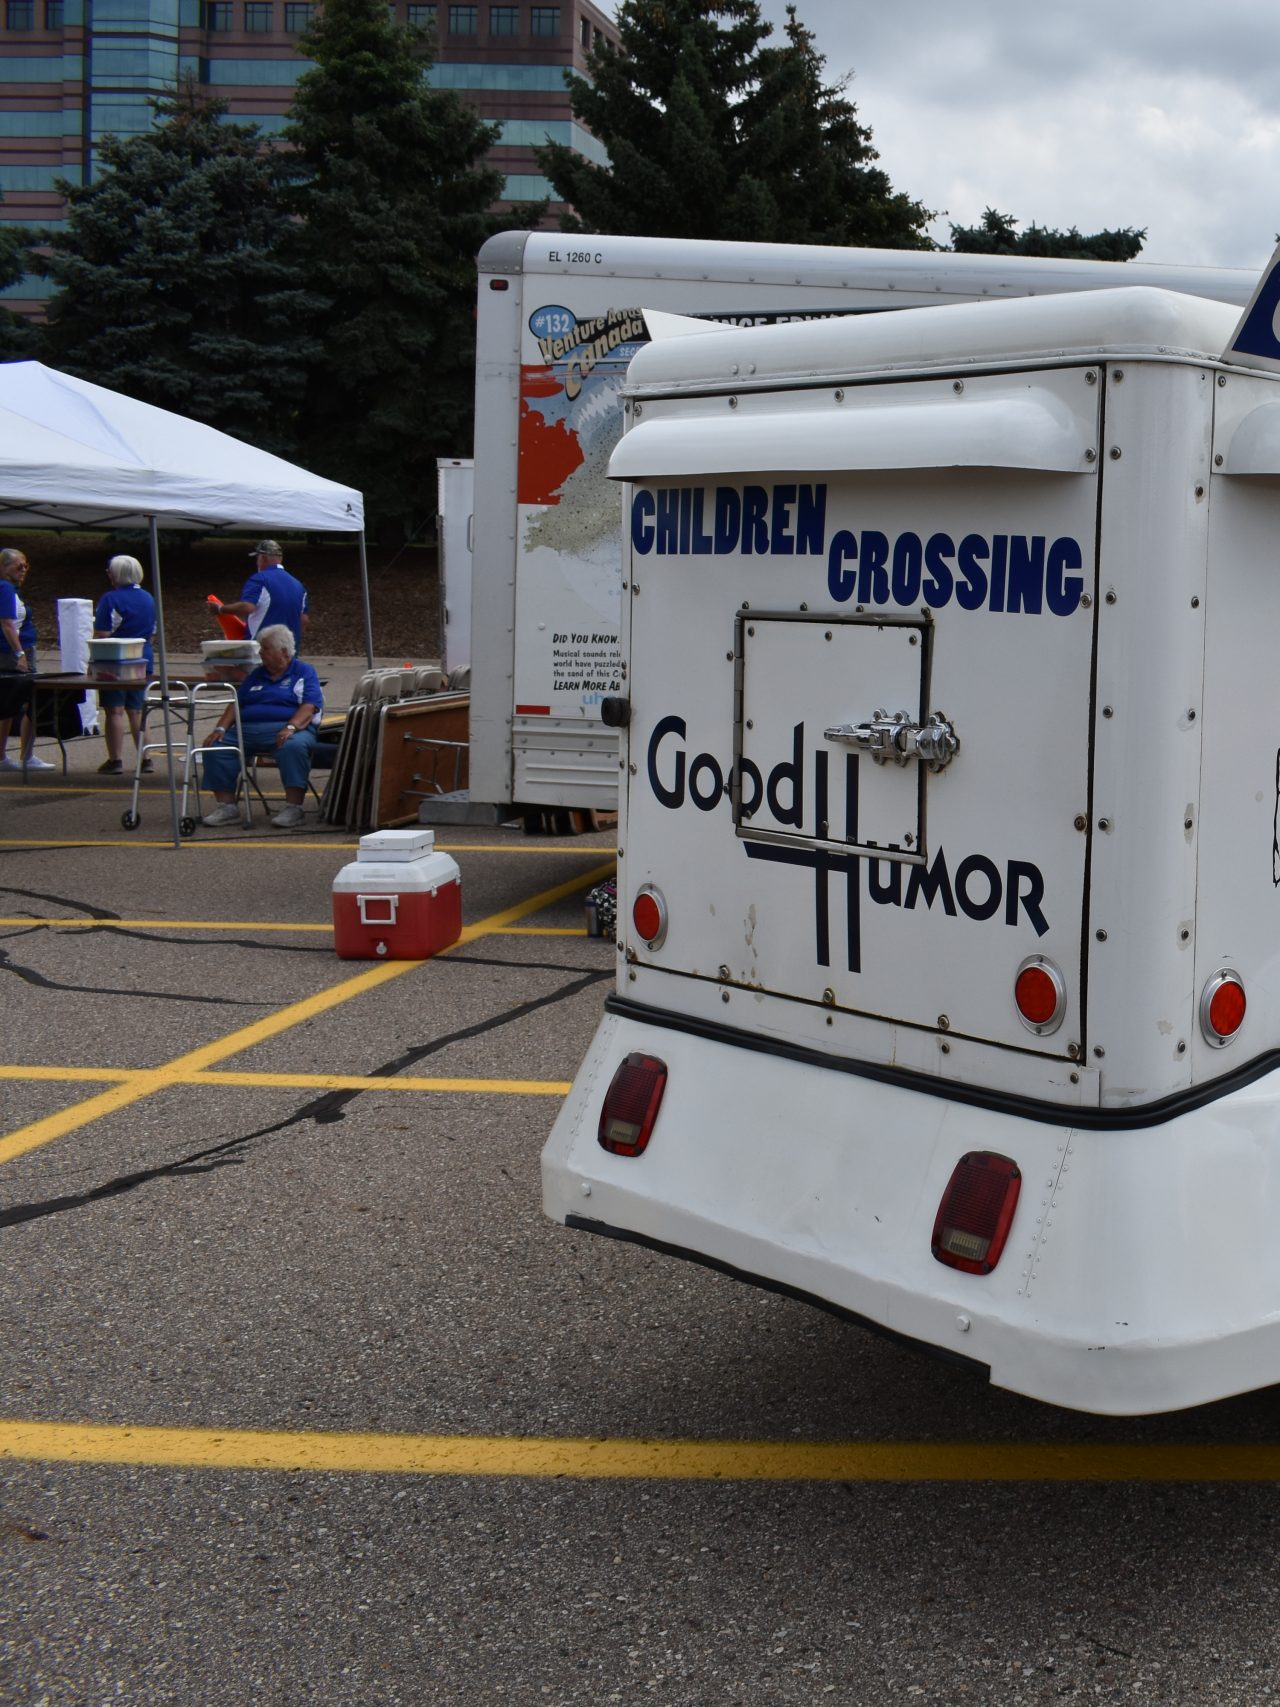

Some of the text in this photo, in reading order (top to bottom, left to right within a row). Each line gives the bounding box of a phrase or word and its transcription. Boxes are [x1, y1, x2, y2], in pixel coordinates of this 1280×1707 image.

[549, 251, 602, 264] EL 1260 C
[535, 313, 570, 333] #132
[538, 318, 605, 366] Venture
[565, 319, 643, 401] Canada
[631, 484, 828, 556] CHILDREN
[827, 529, 1085, 617] CROSSING
[552, 633, 568, 644] DID
[571, 633, 589, 644] YOU
[553, 649, 580, 658] Musical
[582, 650, 607, 658] sounds
[553, 660, 620, 669] world have puzzled
[553, 669, 565, 677] the
[567, 669, 584, 678] sand
[586, 669, 595, 678] of
[596, 669, 610, 678] this
[553, 680, 580, 691] LEARN
[581, 680, 607, 691] MORE
[648, 715, 805, 829] Good
